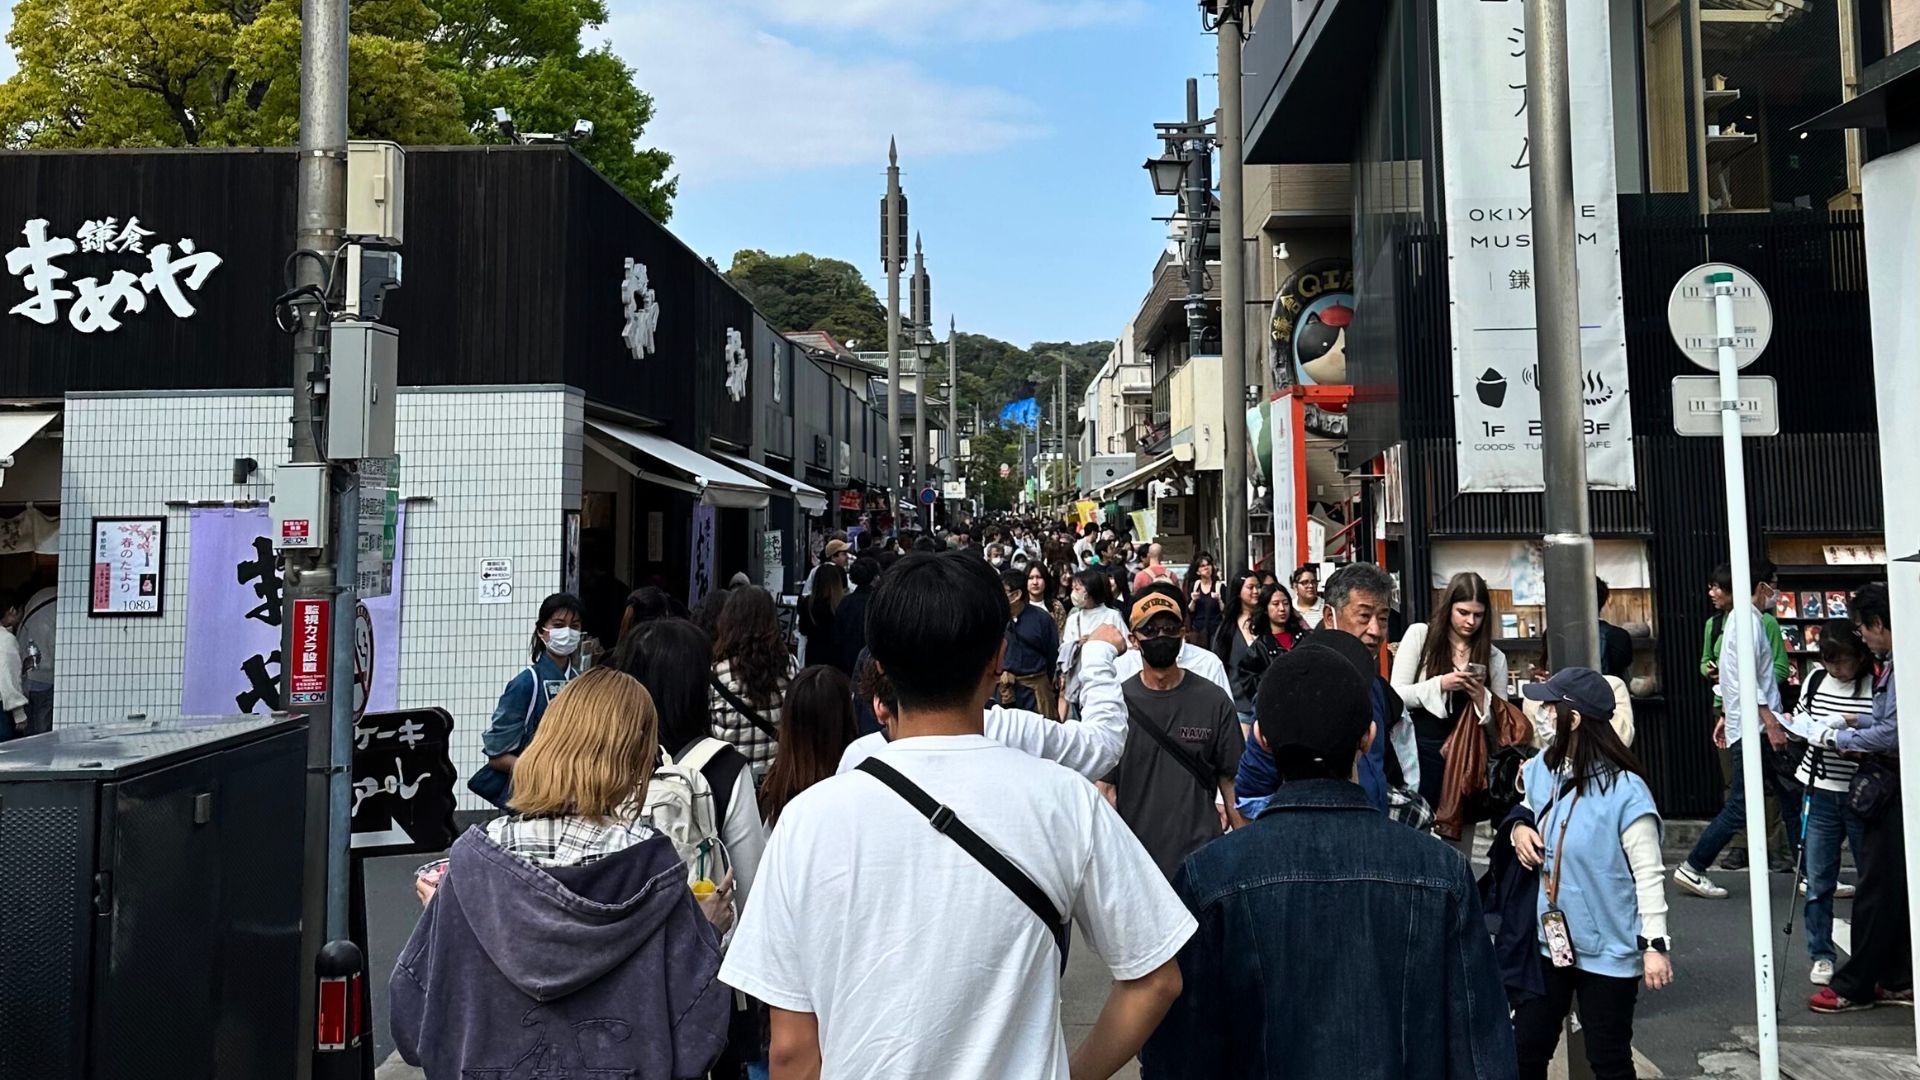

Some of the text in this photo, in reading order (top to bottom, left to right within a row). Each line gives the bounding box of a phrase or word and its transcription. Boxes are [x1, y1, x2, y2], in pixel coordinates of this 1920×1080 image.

[1468, 204, 1597, 222] OKIYE
[76, 216, 156, 254] 鎌倉
[1470, 232, 1597, 249] MUSM
[5, 217, 224, 333] まめや
[1482, 420, 1505, 437] 1F
[1474, 443, 1516, 451] GOODS
[292, 693, 326, 702] SECOM
[1180, 726, 1212, 739] NAVY
